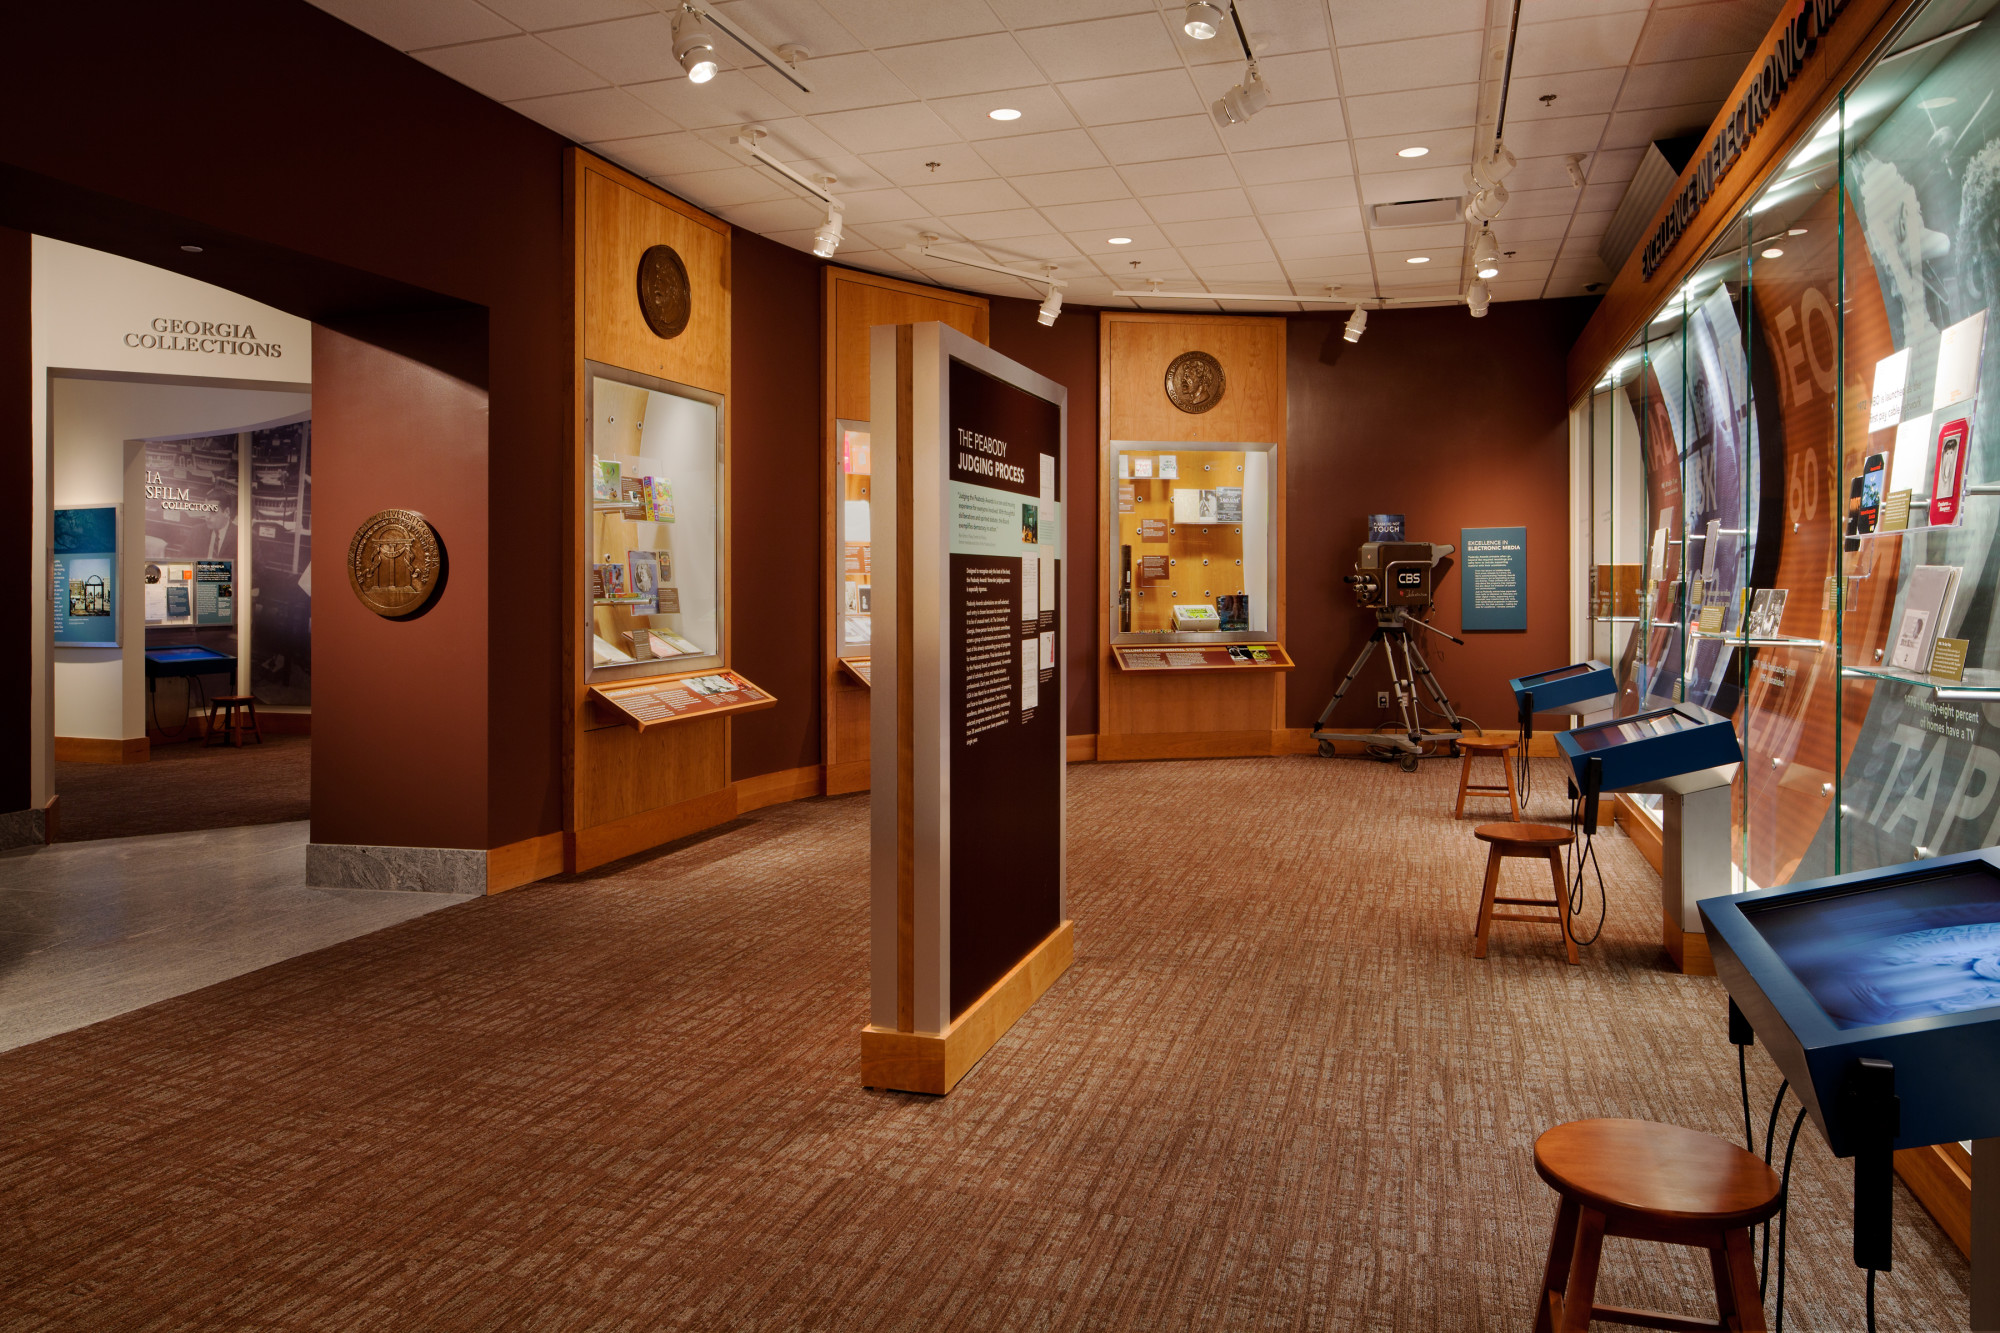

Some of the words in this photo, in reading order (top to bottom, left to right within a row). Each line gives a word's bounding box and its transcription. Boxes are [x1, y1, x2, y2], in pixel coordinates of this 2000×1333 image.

[1712, 9, 1809, 179] ELECTRONIC
[150, 317, 257, 340] GEORGIA
[123, 333, 282, 358] COLLECTIONS
[958, 428, 973, 449] THE
[974, 432, 1007, 458] PEABODY
[958, 452, 994, 477] JUDGING
[995, 461, 1025, 484] PROCESS
[1789, 447, 1819, 524] 60
[161, 501, 219, 512] COLLECTIONS
[1398, 573, 1420, 584] CBS
[1920, 698, 1954, 719] Ninety-eight
[1955, 709, 1979, 724] percent
[1920, 716, 1926, 728] of
[1926, 717, 1945, 734] homes
[1945, 722, 1960, 738] have
[1961, 730, 1965, 740] a
[1966, 727, 1975, 742] TV
[1868, 723, 2000, 858] TAP
